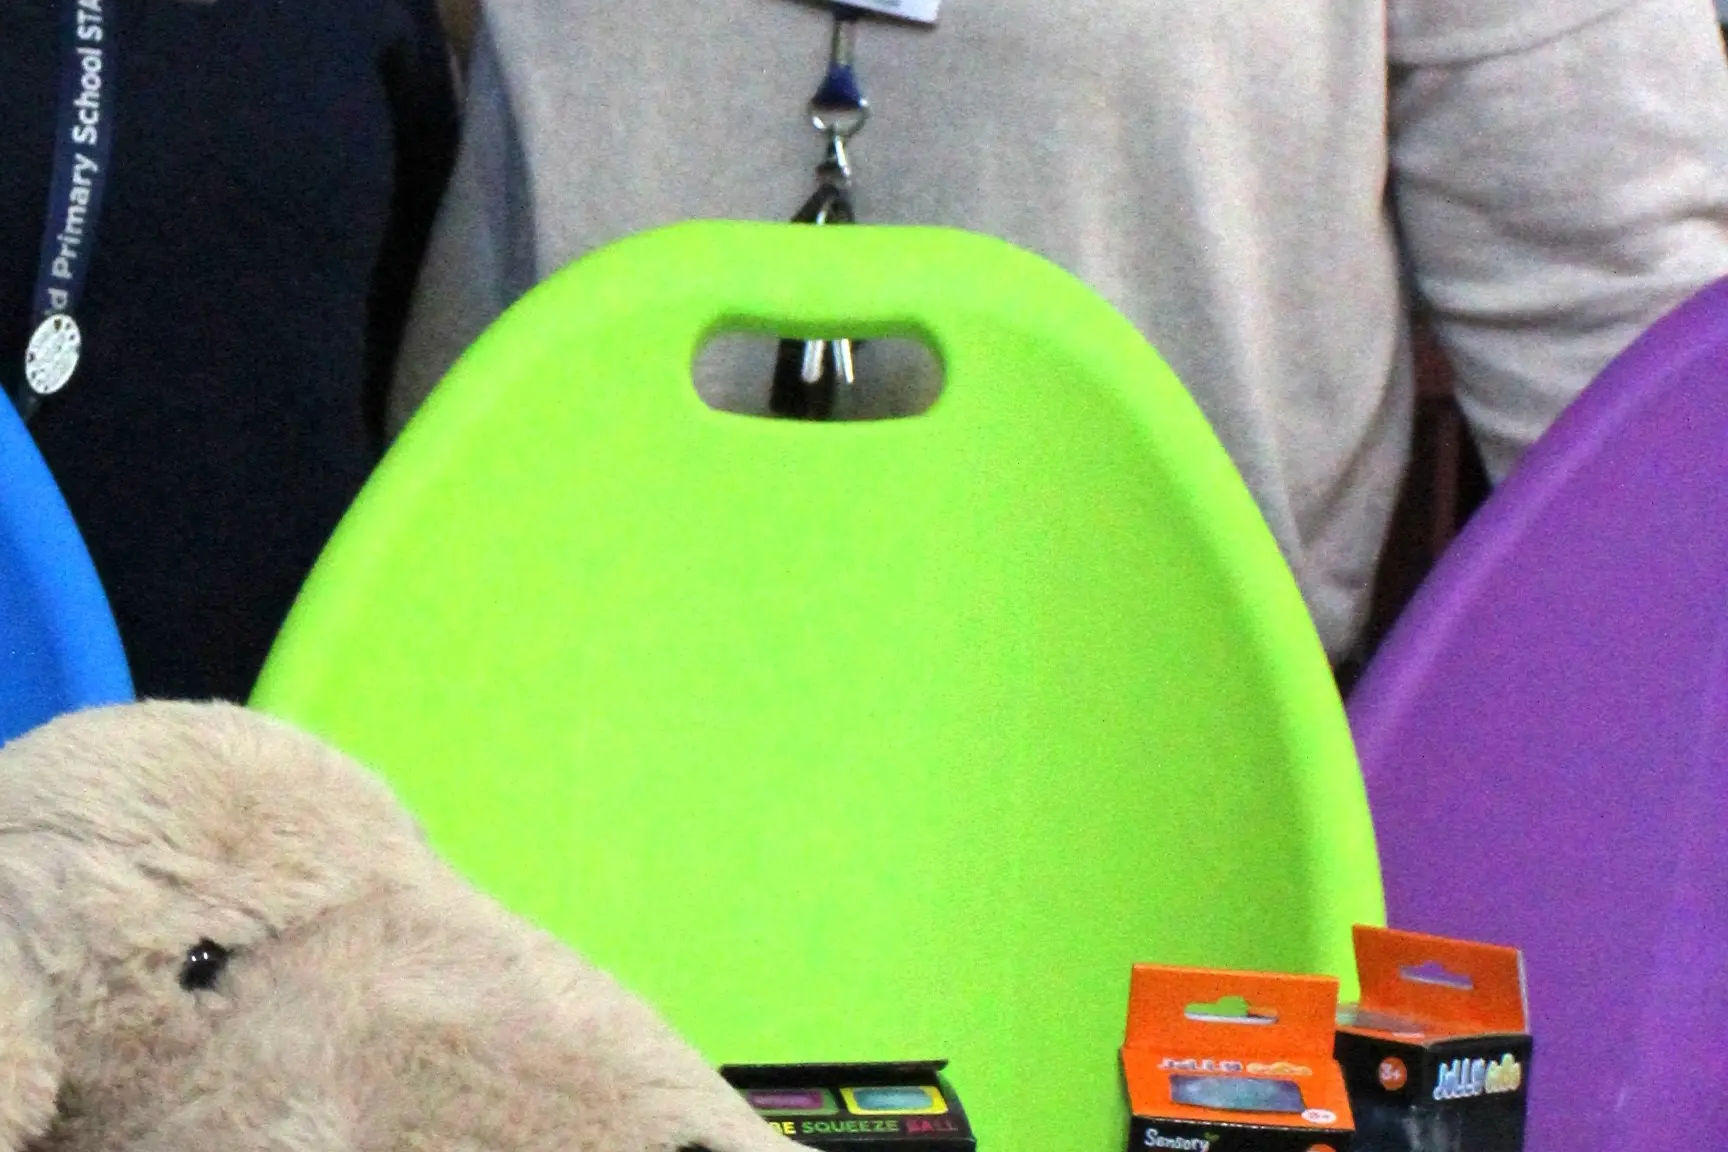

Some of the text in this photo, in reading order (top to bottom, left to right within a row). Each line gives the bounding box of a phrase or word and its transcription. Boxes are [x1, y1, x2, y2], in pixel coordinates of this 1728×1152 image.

[72, 48, 103, 146] School
[51, 153, 99, 280] Primary
[801, 1120, 900, 1135] SQUEEZE
[1143, 1127, 1210, 1152] Sensory
